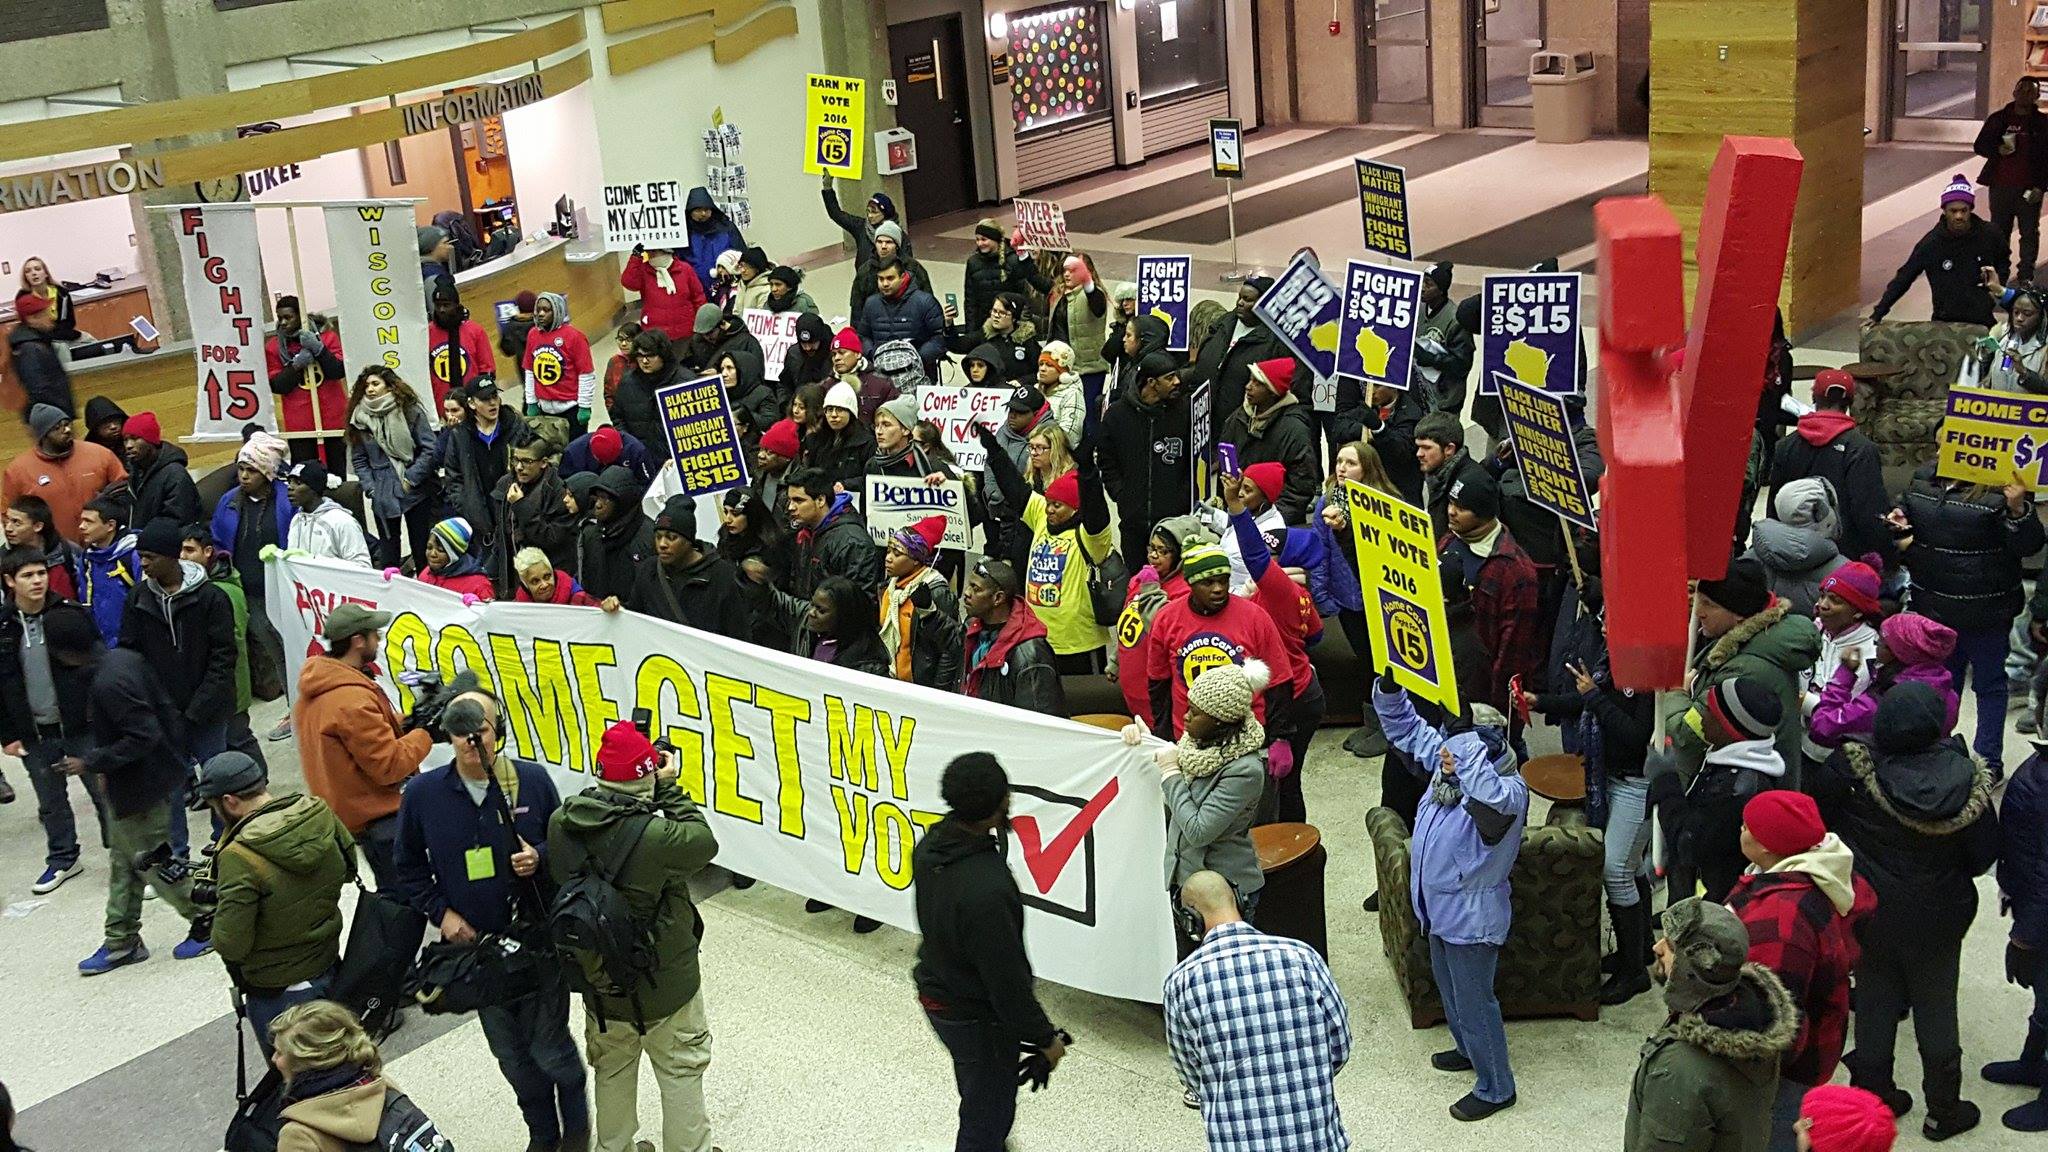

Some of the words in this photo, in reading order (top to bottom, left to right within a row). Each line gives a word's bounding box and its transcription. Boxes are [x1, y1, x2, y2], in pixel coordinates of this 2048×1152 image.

[811, 78, 839, 90] EARN
[845, 81, 860, 92] MY
[402, 75, 544, 135] INFORMATION
[821, 95, 850, 108] VOTE
[823, 113, 848, 125] 2016
[825, 144, 844, 160] 15
[1360, 164, 1382, 178] BLACK
[1382, 169, 1401, 182] LIVES
[1361, 174, 1402, 194] MATTER
[604, 184, 643, 206] COME
[647, 181, 677, 203] GET
[1363, 191, 1403, 210] IMMIGRANT
[607, 208, 627, 232] MY
[1015, 200, 1053, 221] RIVER
[1364, 201, 1404, 222] JUSTICE
[1366, 217, 1405, 239] FIGHT
[1374, 233, 1408, 254] $15
[1142, 261, 1186, 279] FIGHT
[1141, 279, 1149, 304] FOR
[1149, 278, 1186, 304] $15
[1351, 269, 1415, 300] FIGHT
[1492, 282, 1571, 303] FIGHT
[1348, 290, 1361, 320] FOR
[1359, 291, 1412, 328] $15
[747, 313, 780, 336] COME
[1491, 306, 1504, 336] FOR
[1504, 303, 1571, 336] $15
[202, 345, 241, 364] FOR
[537, 362, 558, 381] 15
[665, 390, 694, 408] BLACK
[693, 384, 719, 402] LIVES
[667, 396, 721, 421] MATTER
[923, 391, 958, 412] COME
[970, 391, 1001, 413] GET
[1502, 384, 1533, 409] BLACK
[1533, 396, 1560, 417] LIVES
[1506, 400, 1564, 434] MATTER
[1953, 397, 2023, 421] HOME
[2028, 407, 2048, 423] C
[672, 415, 726, 440] IMMIGRANT
[1512, 420, 1568, 456] IMMIGRANT
[676, 428, 731, 454] JUSTICE
[1946, 430, 2013, 452] FIGHT
[681, 447, 734, 473] FIGHT
[1517, 436, 1574, 473] JUSTICE
[1953, 450, 1998, 472] FOR
[2013, 434, 2048, 486] $1
[684, 471, 697, 491] FOR
[694, 463, 741, 489] $15
[1523, 457, 1578, 495] FIGHT
[871, 481, 958, 507] Bernie
[1538, 480, 1586, 516] $15
[949, 516, 964, 526] 016
[1350, 488, 1394, 522] COME
[1399, 508, 1430, 539] GET
[869, 526, 886, 540] The
[943, 531, 965, 544] oice!
[1359, 521, 1381, 547] MY
[1387, 533, 1431, 571] VOTE
[1031, 556, 1060, 572] Child
[1031, 568, 1058, 583] Care
[1381, 564, 1418, 596] 2016
[1040, 588, 1056, 603] $15
[1118, 613, 1140, 643] 15
[1406, 604, 1428, 633] Care
[1181, 637, 1210, 657] Home
[1210, 636, 1237, 657] Care
[1190, 654, 1211, 663] Fight
[1212, 654, 1227, 662] For
[1396, 628, 1425, 665] 15
[384, 611, 622, 777] COME
[635, 653, 812, 841] GET
[823, 693, 917, 801] MY
[829, 784, 946, 891] VO
